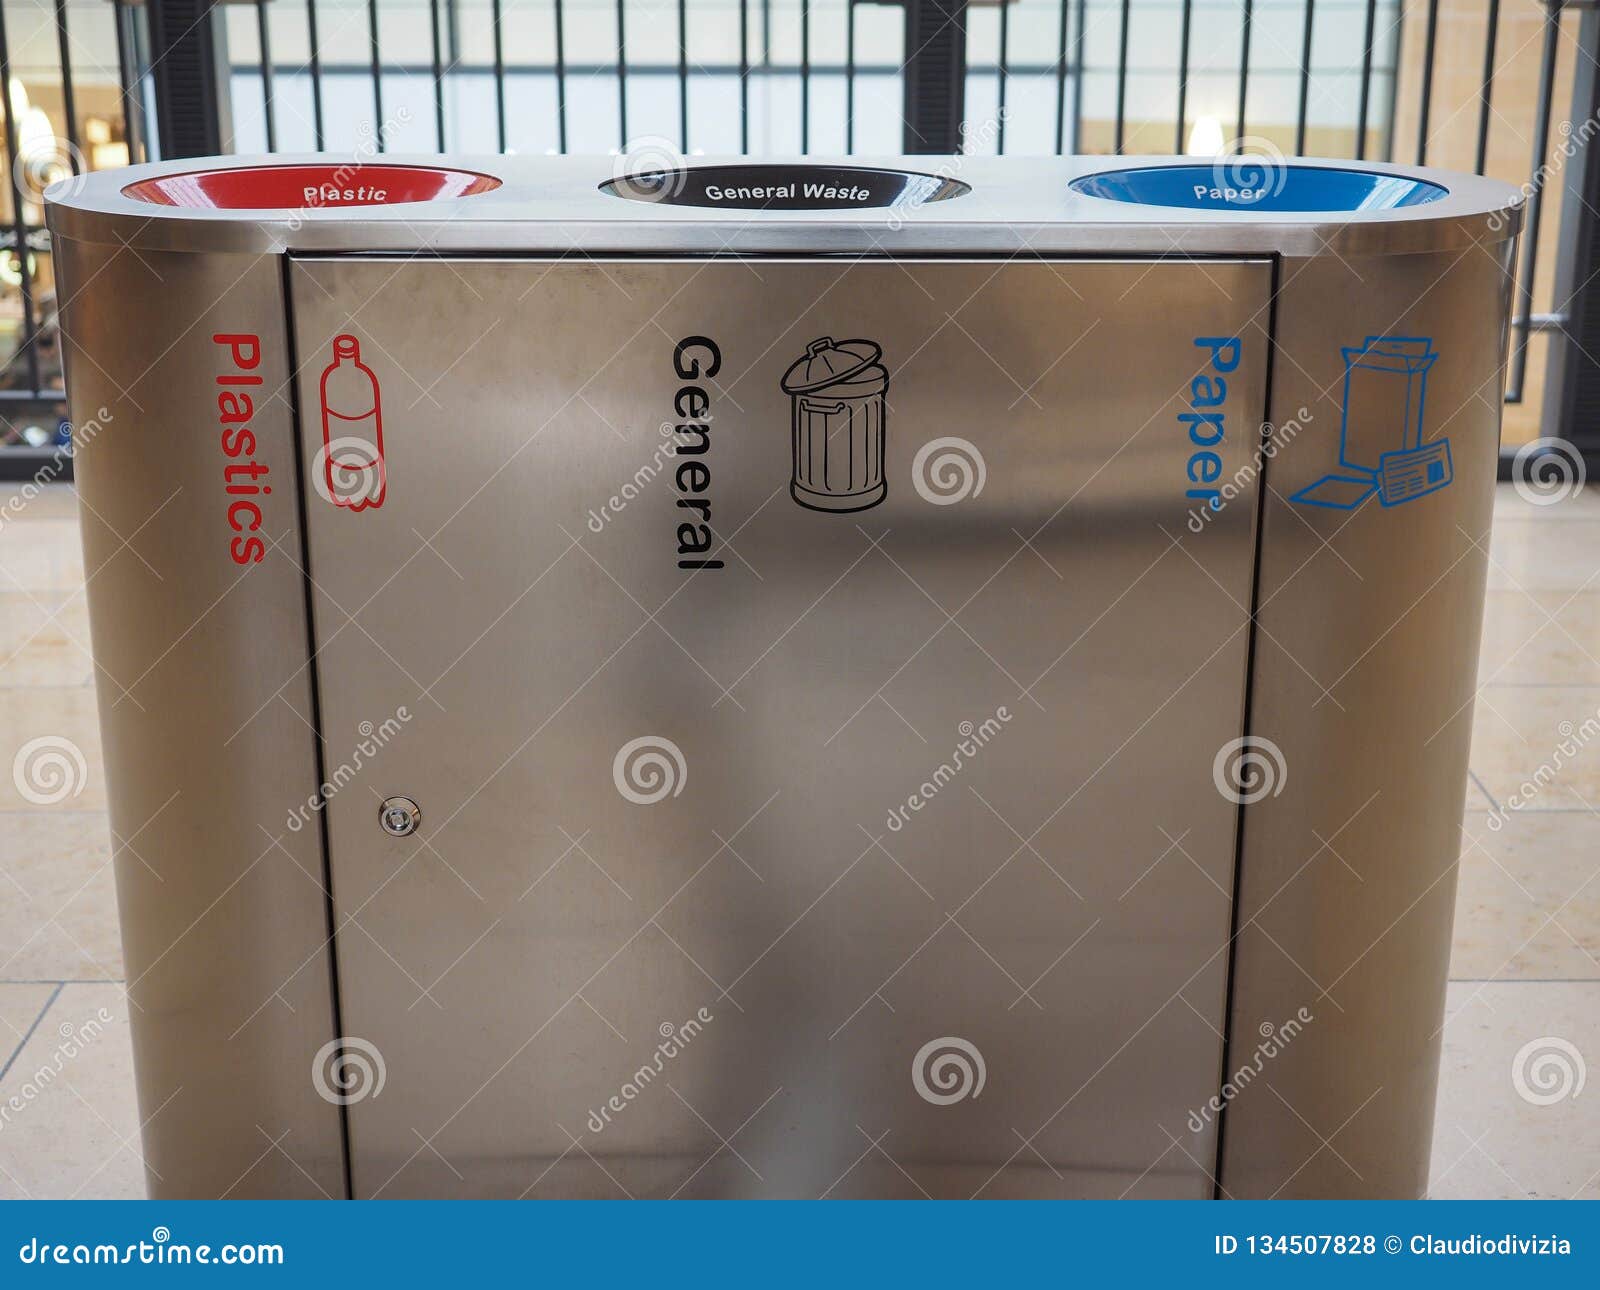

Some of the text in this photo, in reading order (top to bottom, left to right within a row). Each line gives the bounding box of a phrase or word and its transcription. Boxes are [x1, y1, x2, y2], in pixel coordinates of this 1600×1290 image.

[303, 186, 388, 202] Plastic
[705, 183, 870, 201] General Waste
[1193, 185, 1266, 202] Paper
[212, 334, 272, 565] Plastics
[673, 335, 725, 569] General
[1177, 337, 1242, 511] Paper
